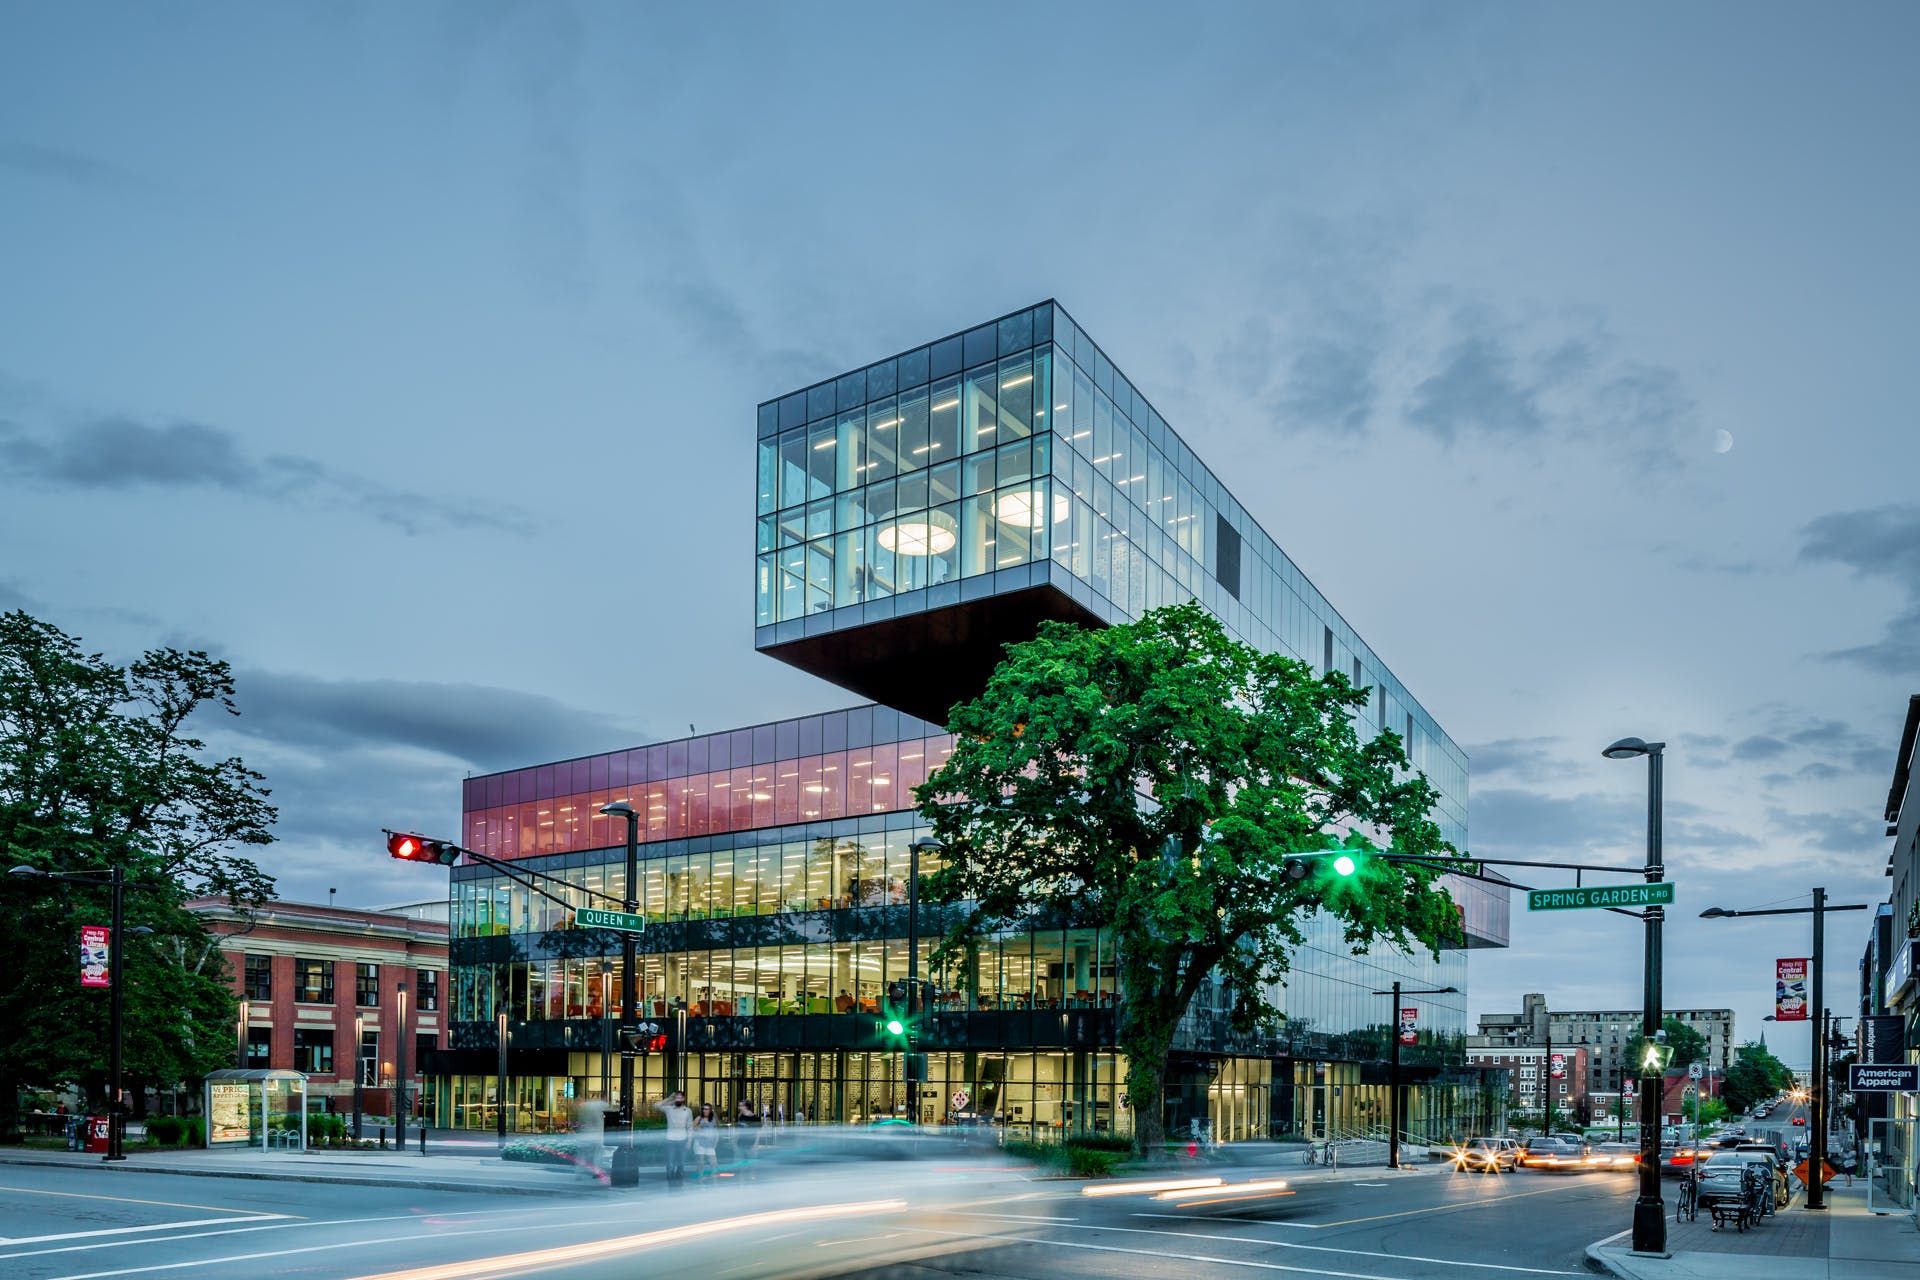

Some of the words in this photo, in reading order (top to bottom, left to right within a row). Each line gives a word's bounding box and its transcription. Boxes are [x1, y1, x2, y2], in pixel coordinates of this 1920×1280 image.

[1534, 892, 1585, 907] SPRING
[1590, 888, 1649, 904] GARDEN
[1656, 890, 1668, 898] RD
[586, 911, 623, 926] QUEEN
[1866, 1019, 1875, 1048] Apparel
[1857, 1069, 1911, 1077] American
[1857, 1077, 1901, 1087] Apparel
